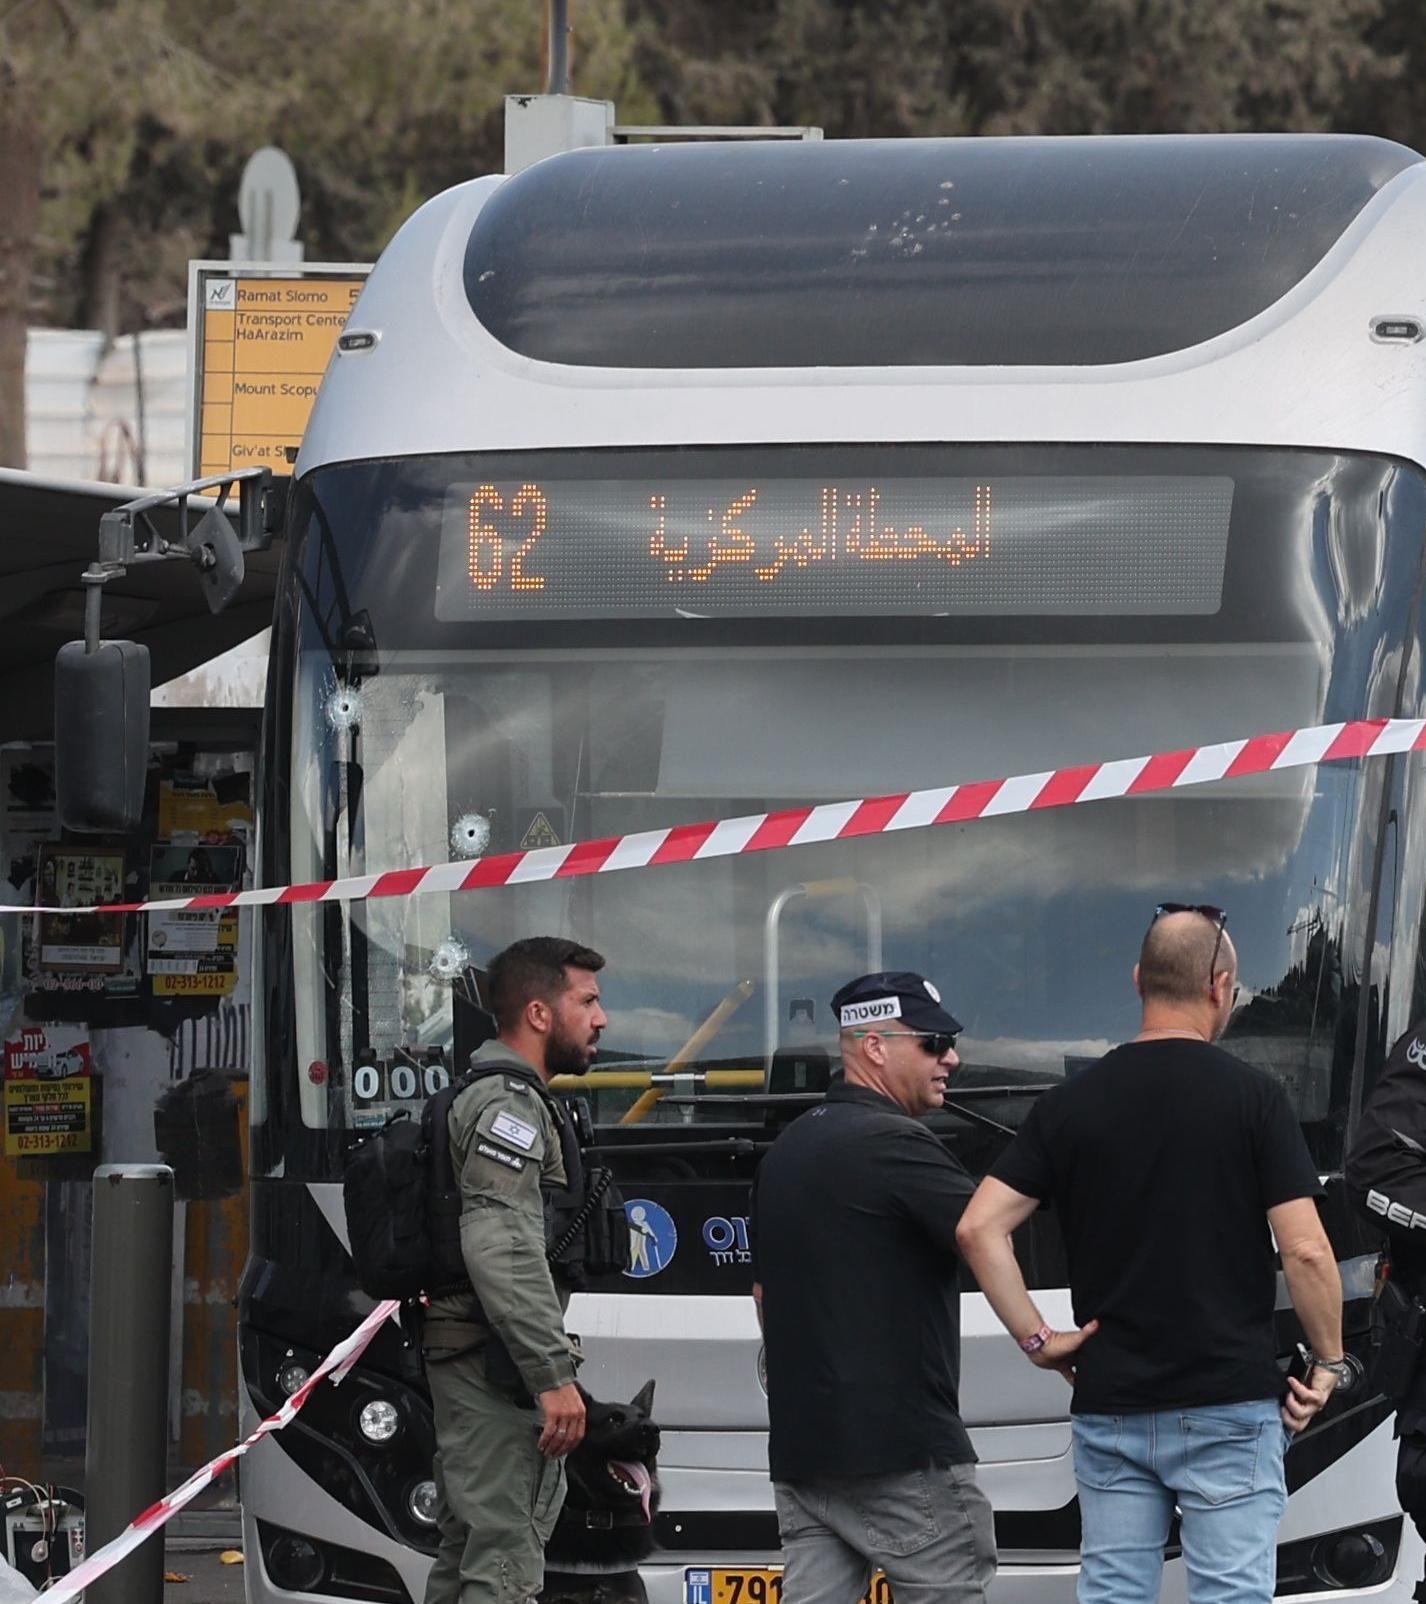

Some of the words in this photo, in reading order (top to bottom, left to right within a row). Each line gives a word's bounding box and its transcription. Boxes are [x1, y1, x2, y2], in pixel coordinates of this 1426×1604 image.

[237, 289, 282, 303] Ramat
[286, 290, 329, 303] Slomo
[237, 313, 302, 327] Transport
[305, 314, 347, 327] Cente
[236, 328, 304, 341] HaArazim
[234, 383, 276, 395] Mount
[232, 445, 271, 457] Giv'at
[846, 485, 993, 566] المحطة
[469, 484, 547, 590] 62
[650, 487, 838, 582] المركزية
[165, 974, 225, 989] 02-313-1212
[843, 1002, 895, 1021] משטרה
[18, 1133, 78, 1150] 02-313-1212
